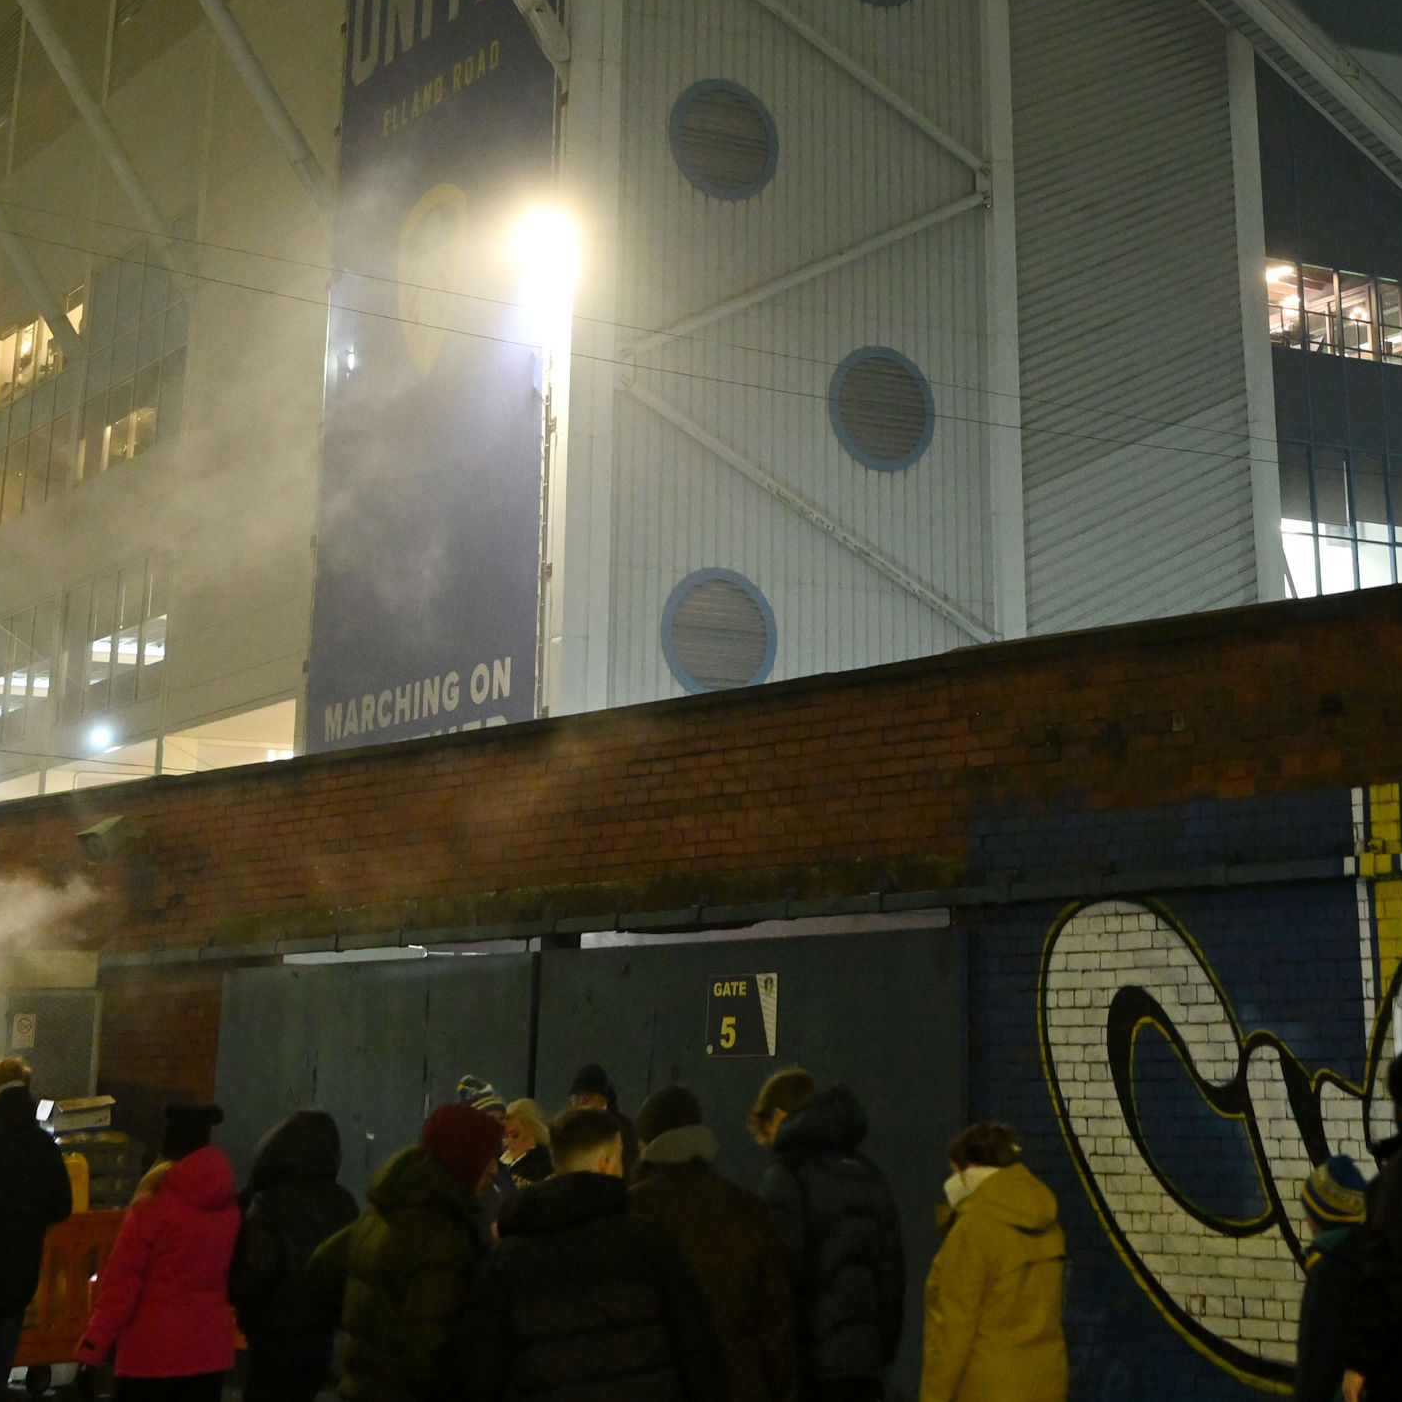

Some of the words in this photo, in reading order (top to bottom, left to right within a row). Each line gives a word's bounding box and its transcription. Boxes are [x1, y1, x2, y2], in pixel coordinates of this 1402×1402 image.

[383, 73, 445, 137] ELLAND
[453, 39, 500, 93] ROAD
[324, 670, 460, 743] MARCHING
[470, 656, 512, 705] ON
[713, 981, 748, 997] GATE
[720, 1016, 737, 1049] 5
